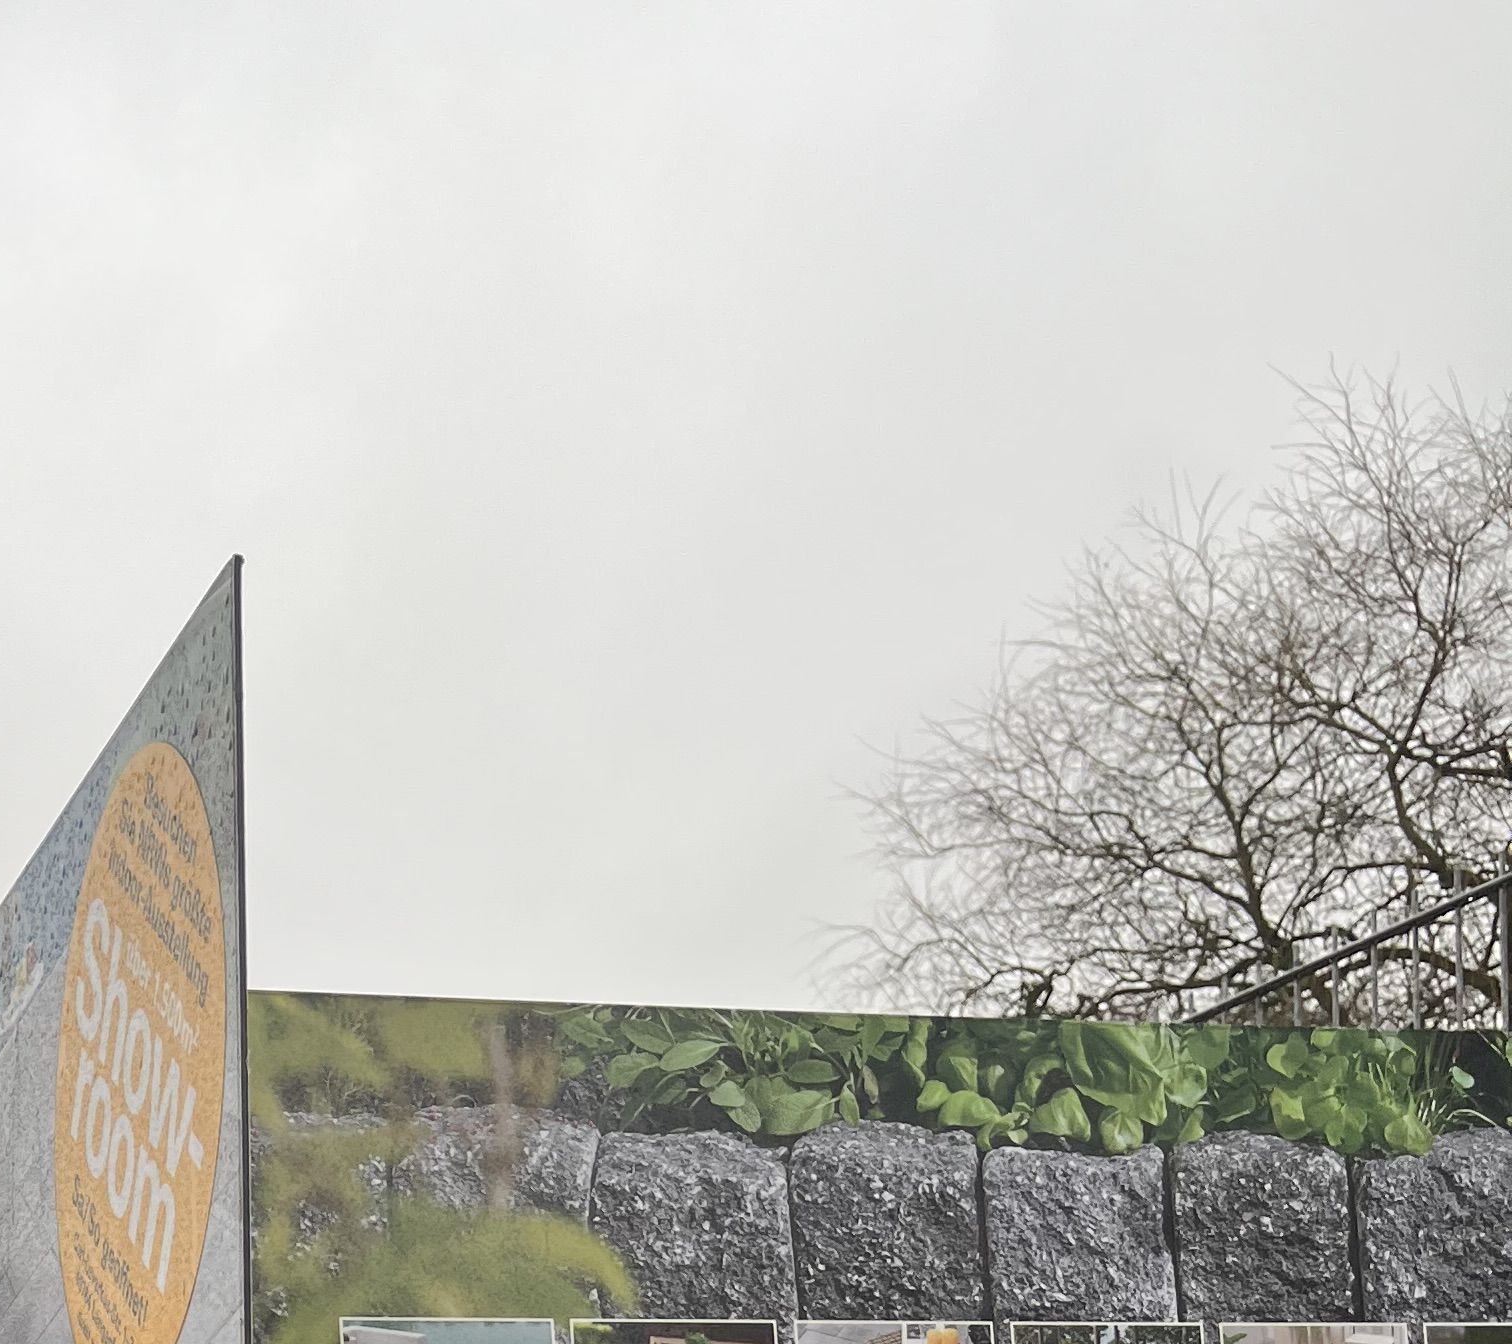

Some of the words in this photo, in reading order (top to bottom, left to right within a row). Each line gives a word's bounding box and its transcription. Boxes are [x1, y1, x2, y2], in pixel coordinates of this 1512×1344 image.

[144, 770, 197, 864] Besuchen
[170, 876, 212, 943] größte
[76, 898, 204, 1177] Show-
[71, 1047, 175, 1295] room
[101, 1238, 148, 1329] geöffnet!
